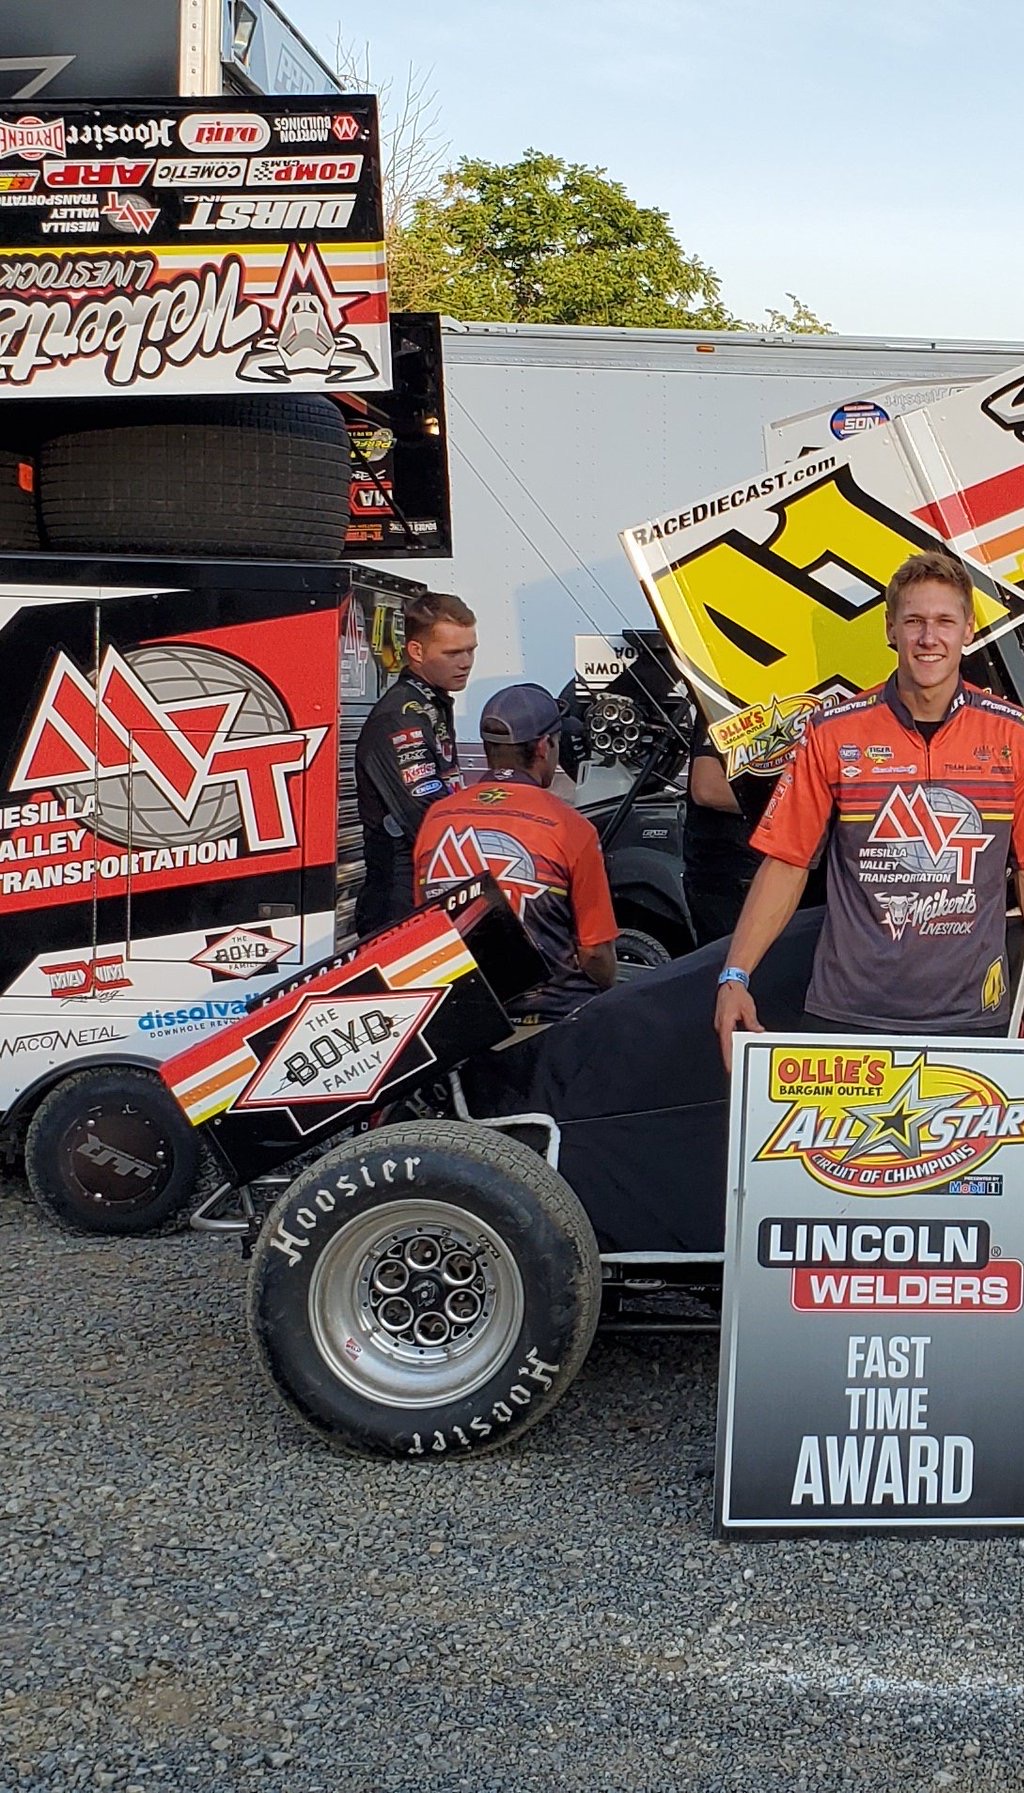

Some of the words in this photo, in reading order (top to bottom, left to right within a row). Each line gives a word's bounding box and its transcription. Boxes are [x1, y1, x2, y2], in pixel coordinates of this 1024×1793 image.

[66, 119, 177, 151] Hoosier
[274, 116, 331, 130] BUILDINGS
[279, 129, 328, 143] MORTON
[47, 164, 151, 185] ARP
[158, 165, 241, 183] COMETIC
[275, 162, 356, 181] COMP
[50, 208, 99, 218] VALLEY
[179, 201, 355, 230] DURST
[42, 222, 99, 233] MESILLA
[735, 739, 766, 769] ALL
[0, 794, 101, 829] ESILLA
[0, 828, 88, 862] ALLEY
[859, 848, 907, 858] MESILLA
[858, 872, 951, 883] TRANSPORTATION
[859, 860, 899, 871] VALLEY
[908, 888, 977, 927] Weikert's
[232, 935, 248, 943] THE
[918, 920, 976, 936] LIVESTOCK
[215, 942, 268, 962] BOYD
[150, 1023, 206, 1039] DOWNHOLE
[305, 1007, 340, 1032] THE
[283, 1009, 393, 1087] BOYD
[322, 1051, 384, 1093] FAMILY
[779, 1085, 834, 1097] BARGAIN
[837, 1086, 883, 1097] OUTLET
[772, 1107, 859, 1151] ALL
[811, 1153, 858, 1181] CIRCUIT
[860, 1169, 881, 1183] OF
[884, 1143, 976, 1183] CHAMPIONS
[950, 1180, 985, 1194] Mobil
[270, 1155, 421, 1268] Hoosier
[769, 1224, 979, 1263] LINCOLN
[810, 1275, 1009, 1306] WELDERS
[847, 1335, 931, 1379] FAST
[407, 1347, 560, 1455] Hoosier
[845, 1387, 928, 1430] TIME
[790, 1435, 975, 1505] AWARD
